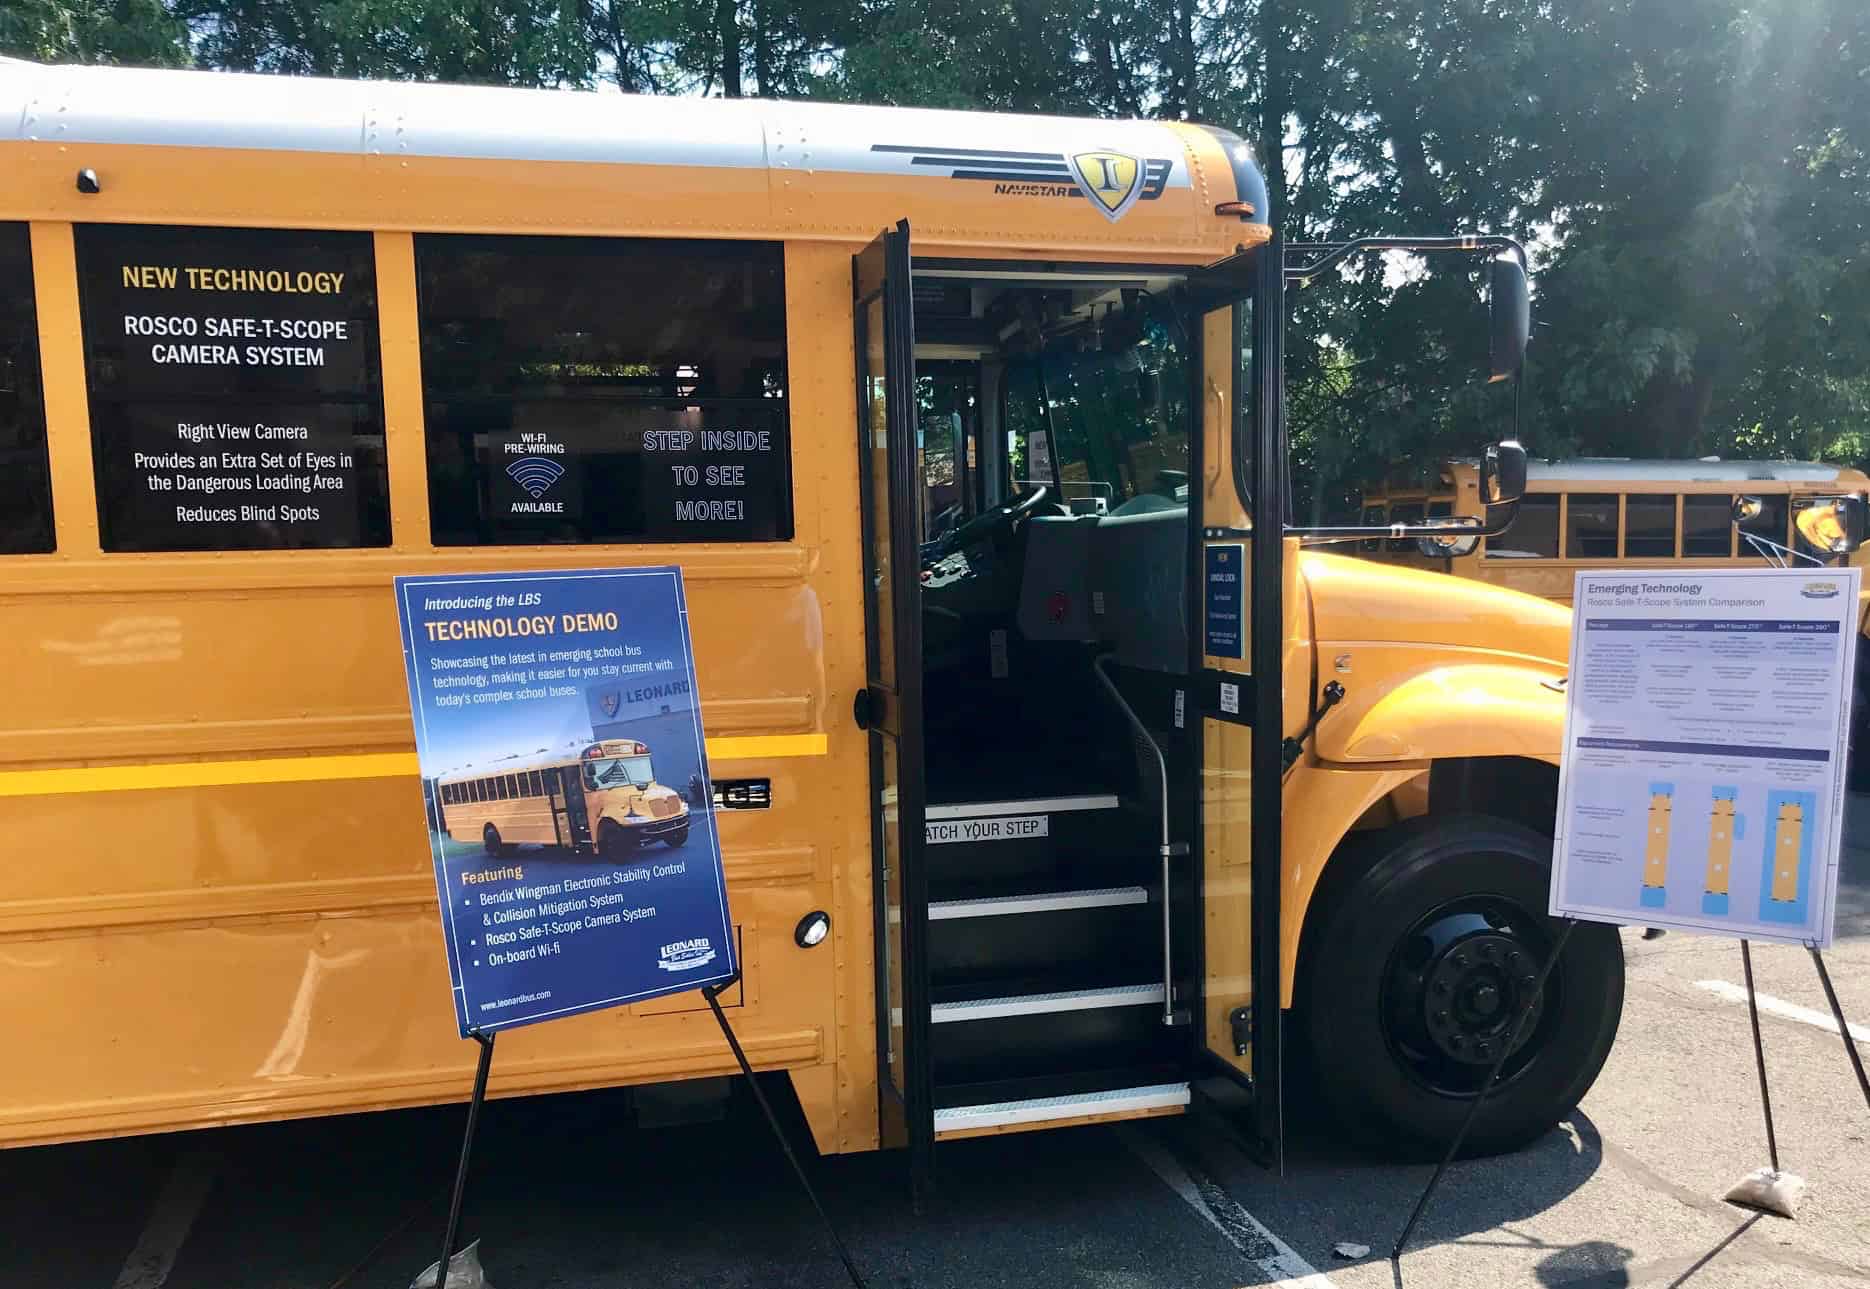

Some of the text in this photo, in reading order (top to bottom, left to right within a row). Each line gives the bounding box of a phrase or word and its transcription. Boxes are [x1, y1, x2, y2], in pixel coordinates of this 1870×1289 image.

[994, 183, 1067, 197] NAVISTAR
[122, 266, 345, 294] NEW TECHNOLOGY
[124, 316, 347, 340] ROSCO SAFE-T-SCOPE
[152, 344, 324, 366] CAMERA SYSTEM
[177, 423, 308, 442] Right View Camera
[521, 433, 546, 443] WI-FI
[643, 430, 771, 451] STEP INSIDE
[504, 444, 565, 454] PRE-WIRING
[135, 453, 352, 472] Provides an Extra Set of Eyes in
[148, 474, 343, 494] the Dangerous Loading Area
[672, 465, 745, 486] TO SEE
[177, 506, 320, 524] Reduces Blind Spots
[511, 502, 563, 513] AVAILABLE
[675, 500, 744, 521] MORE!
[1588, 583, 1702, 595] Emerging Technology
[424, 592, 542, 611] Introducing the LBS
[424, 612, 618, 642] TECHNOLOGY DEMO
[431, 644, 641, 670] Showcasing the latest in emerging school bus
[433, 659, 673, 688] technology, making it easier for you stay current with
[436, 692, 471, 707] today's
[473, 689, 513, 704] complex
[516, 685, 546, 699] school
[627, 680, 690, 703] LEONARD
[925, 820, 1039, 840] ATCH YOUR STEP
[461, 865, 523, 885] Featuring
[480, 862, 686, 905] Bendix Wingman Electronic Stability Control
[483, 893, 624, 926] & Collision Mitigation System
[486, 907, 656, 946] Rosco Safe-T-Scope Camera System
[488, 941, 560, 966] On-board Wi-fi
[661, 938, 710, 959] LEONARD
